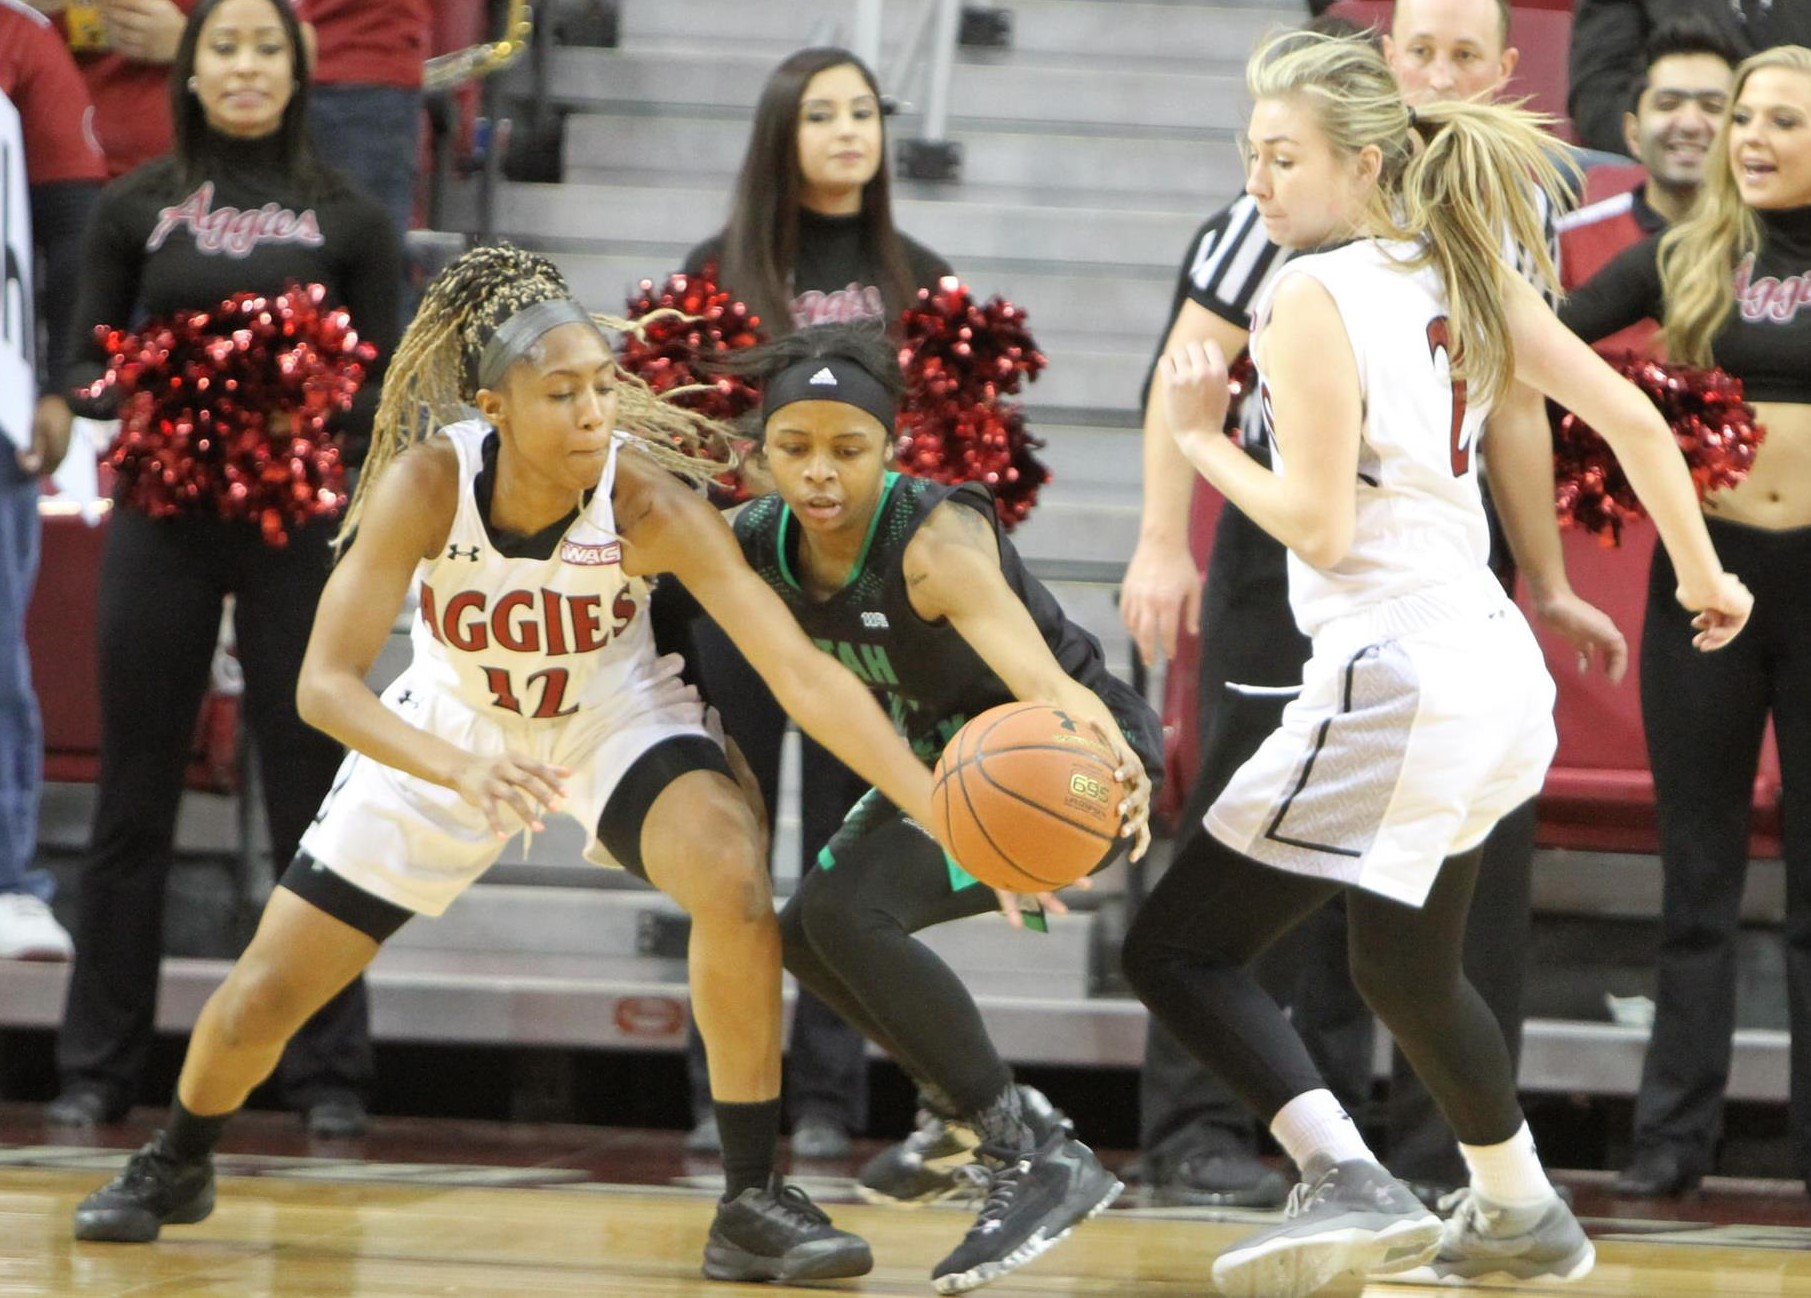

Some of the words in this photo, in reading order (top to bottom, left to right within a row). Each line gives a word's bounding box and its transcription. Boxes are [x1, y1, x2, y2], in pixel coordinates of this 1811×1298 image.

[146, 180, 325, 259] Aggies
[562, 542, 621, 564] WAC
[420, 580, 637, 657] AGGIES
[479, 664, 580, 719] 12
